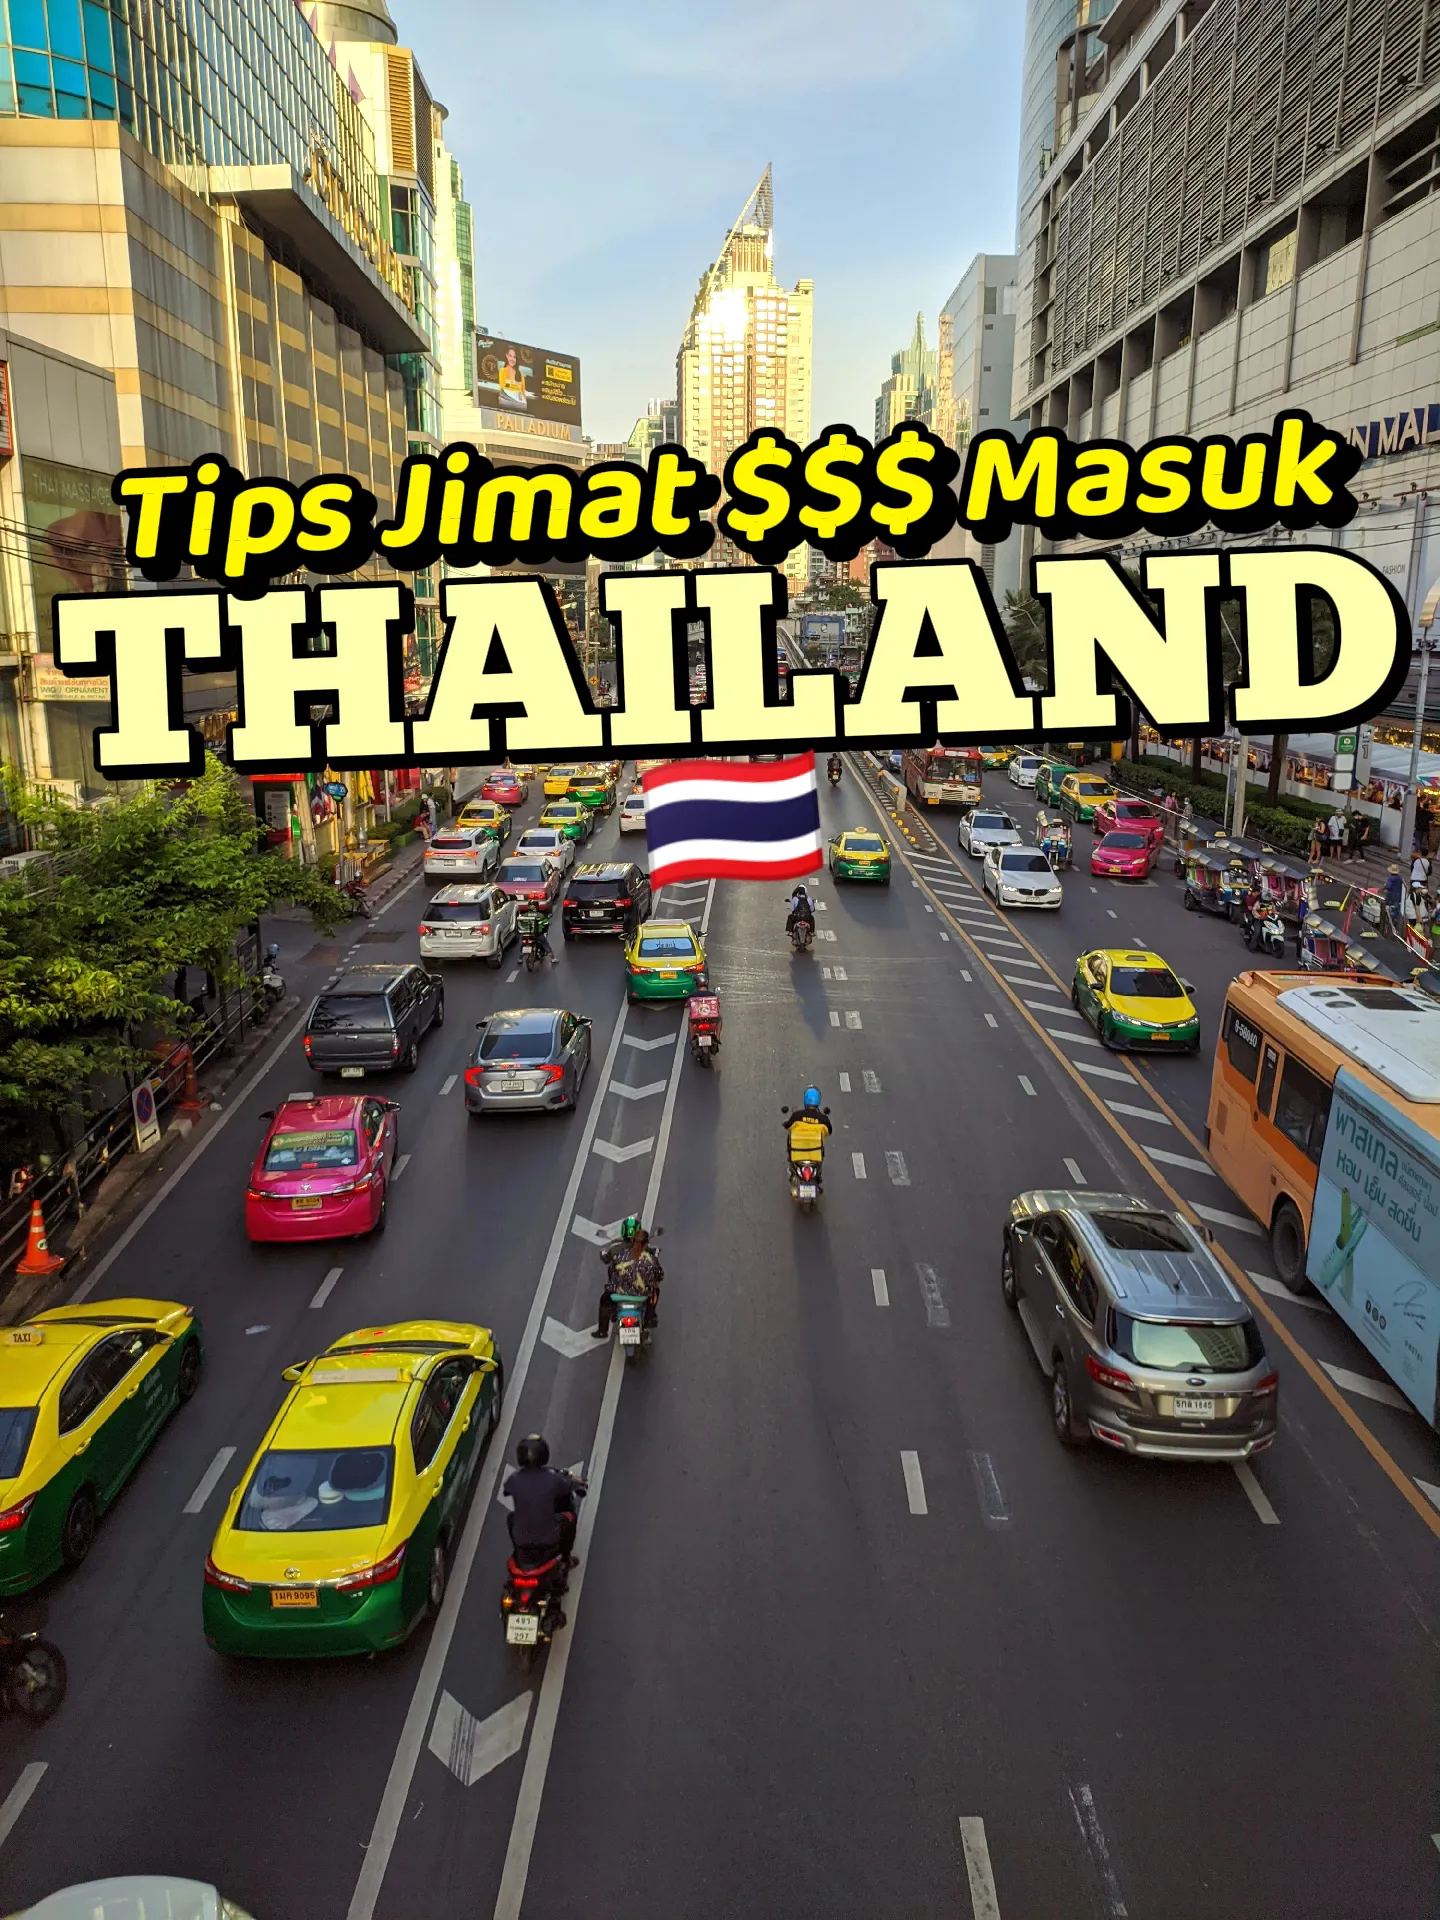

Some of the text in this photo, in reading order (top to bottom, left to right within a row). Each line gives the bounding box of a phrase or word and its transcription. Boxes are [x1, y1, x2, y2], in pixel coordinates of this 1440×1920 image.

[496, 413, 571, 440] PALLADIUM
[32, 472, 59, 494] THAI
[1234, 1019, 1258, 1048] 8-58040
[1335, 1106, 1399, 1180] พาสเทล
[1336, 1149, 1422, 1244] หอม เย็น สดชื่น
[12, 1332, 32, 1343] TAXI
[293, 1591, 316, 1601] 9095
